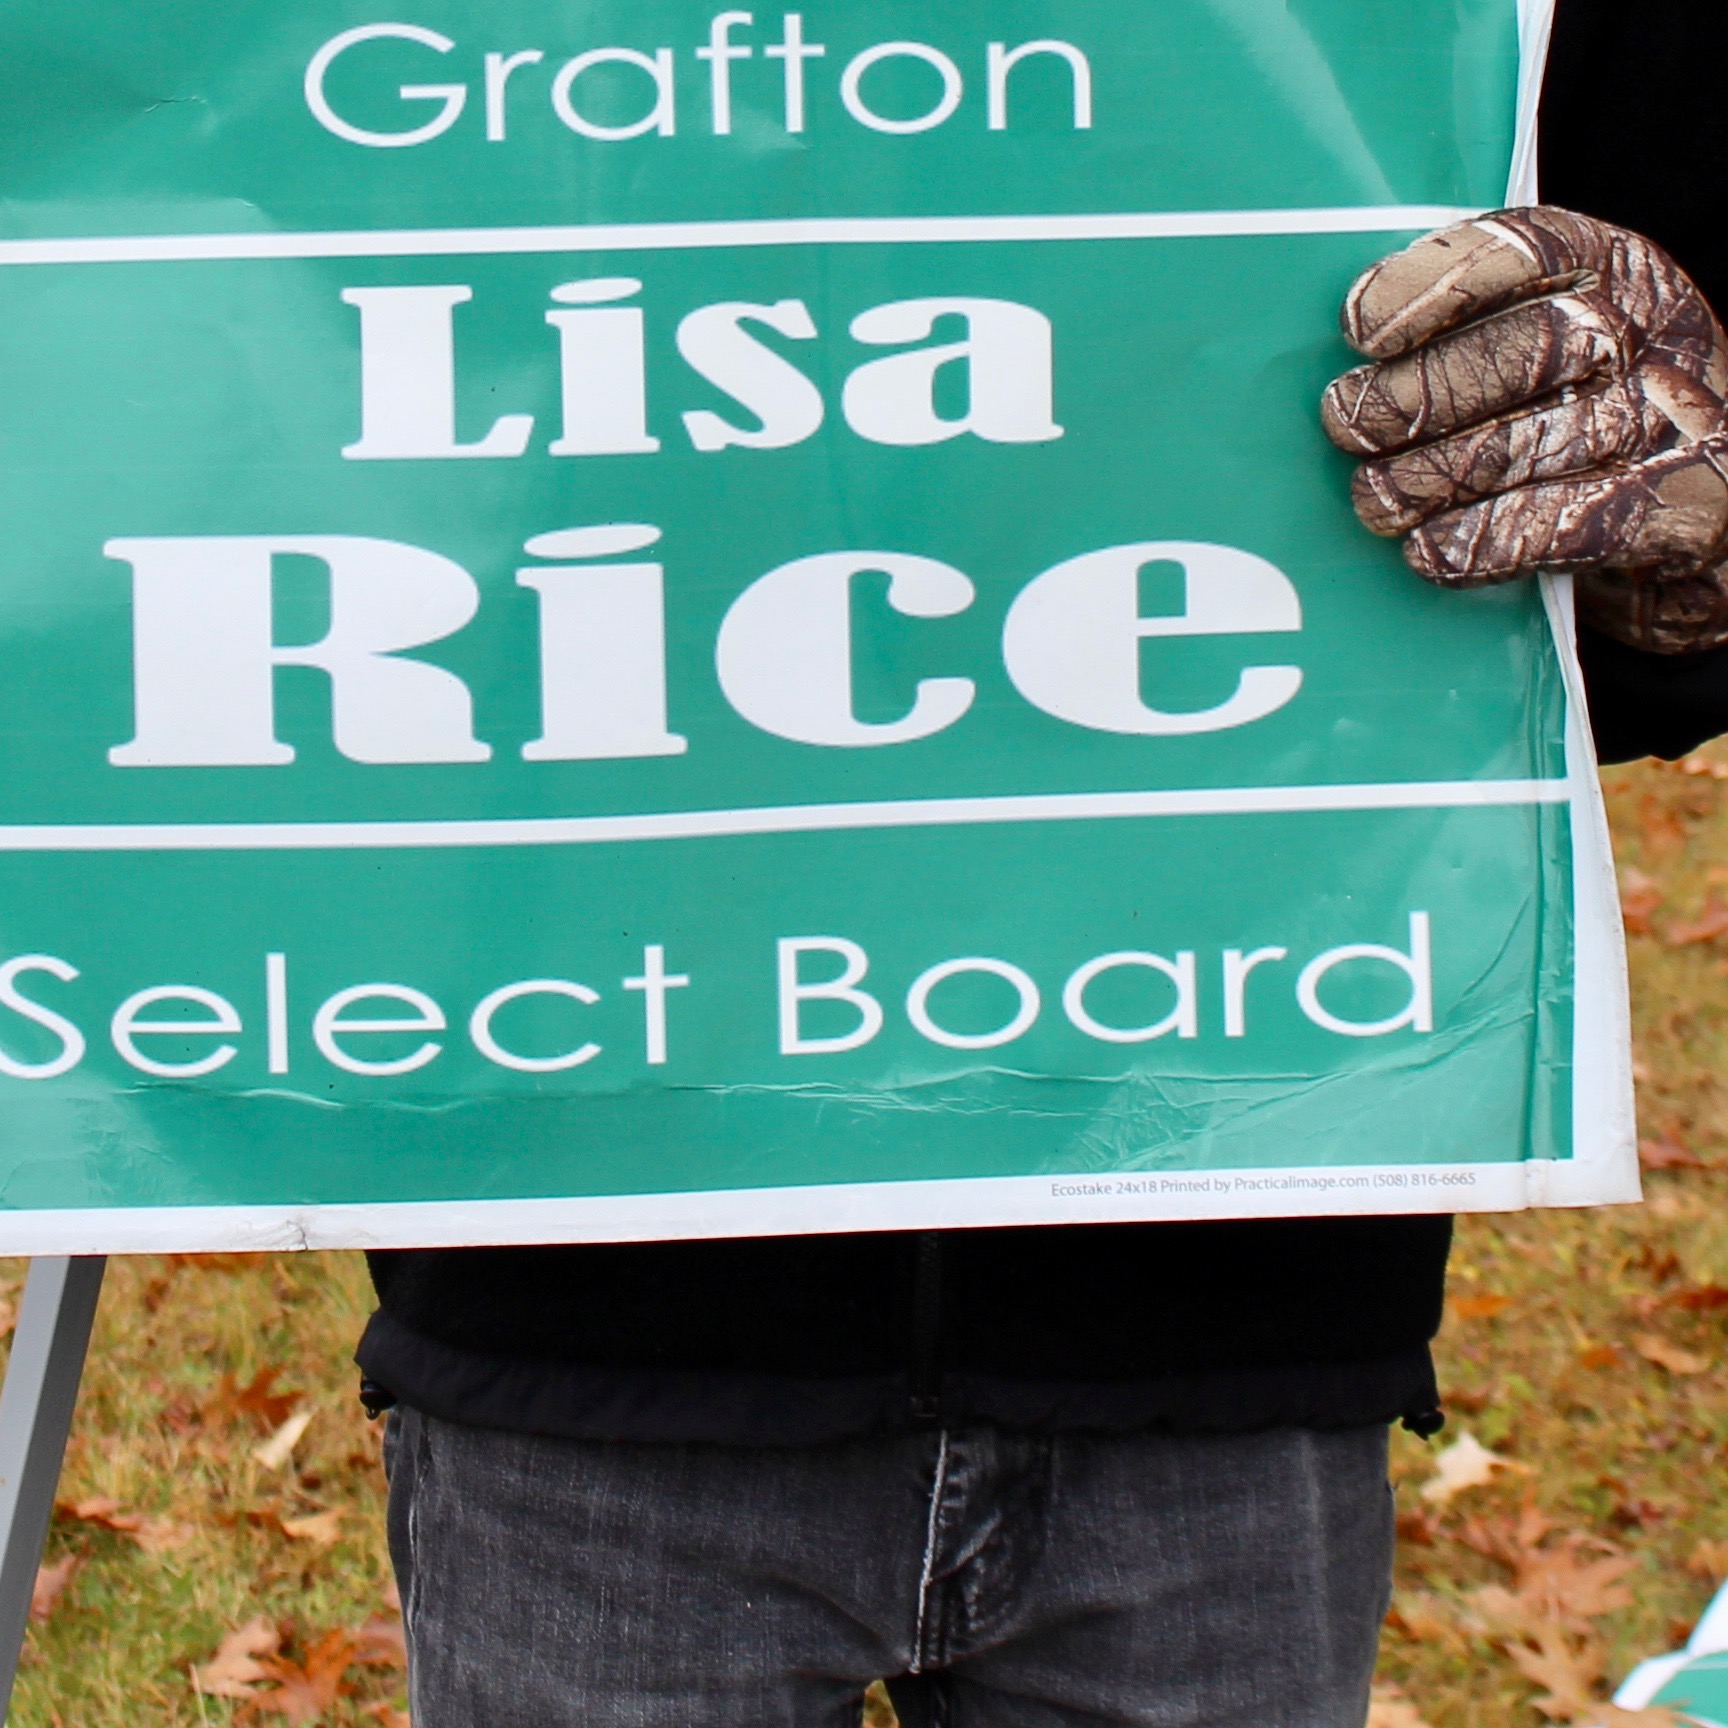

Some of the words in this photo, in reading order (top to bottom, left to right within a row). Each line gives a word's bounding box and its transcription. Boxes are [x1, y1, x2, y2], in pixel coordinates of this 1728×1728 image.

[304, 11, 1091, 147] Grafton
[341, 278, 1064, 460] Lisa
[102, 524, 1303, 766] Rice
[778, 911, 1433, 1055] Board
[1050, 1182, 1113, 1197] Ecostake
[1116, 1180, 1157, 1194] 24x18
[1160, 1178, 1211, 1193] Printed
[1214, 1177, 1232, 1193] by
[1372, 1173, 1409, 1189] (508)
[1411, 1172, 1476, 1187] 816-6665
